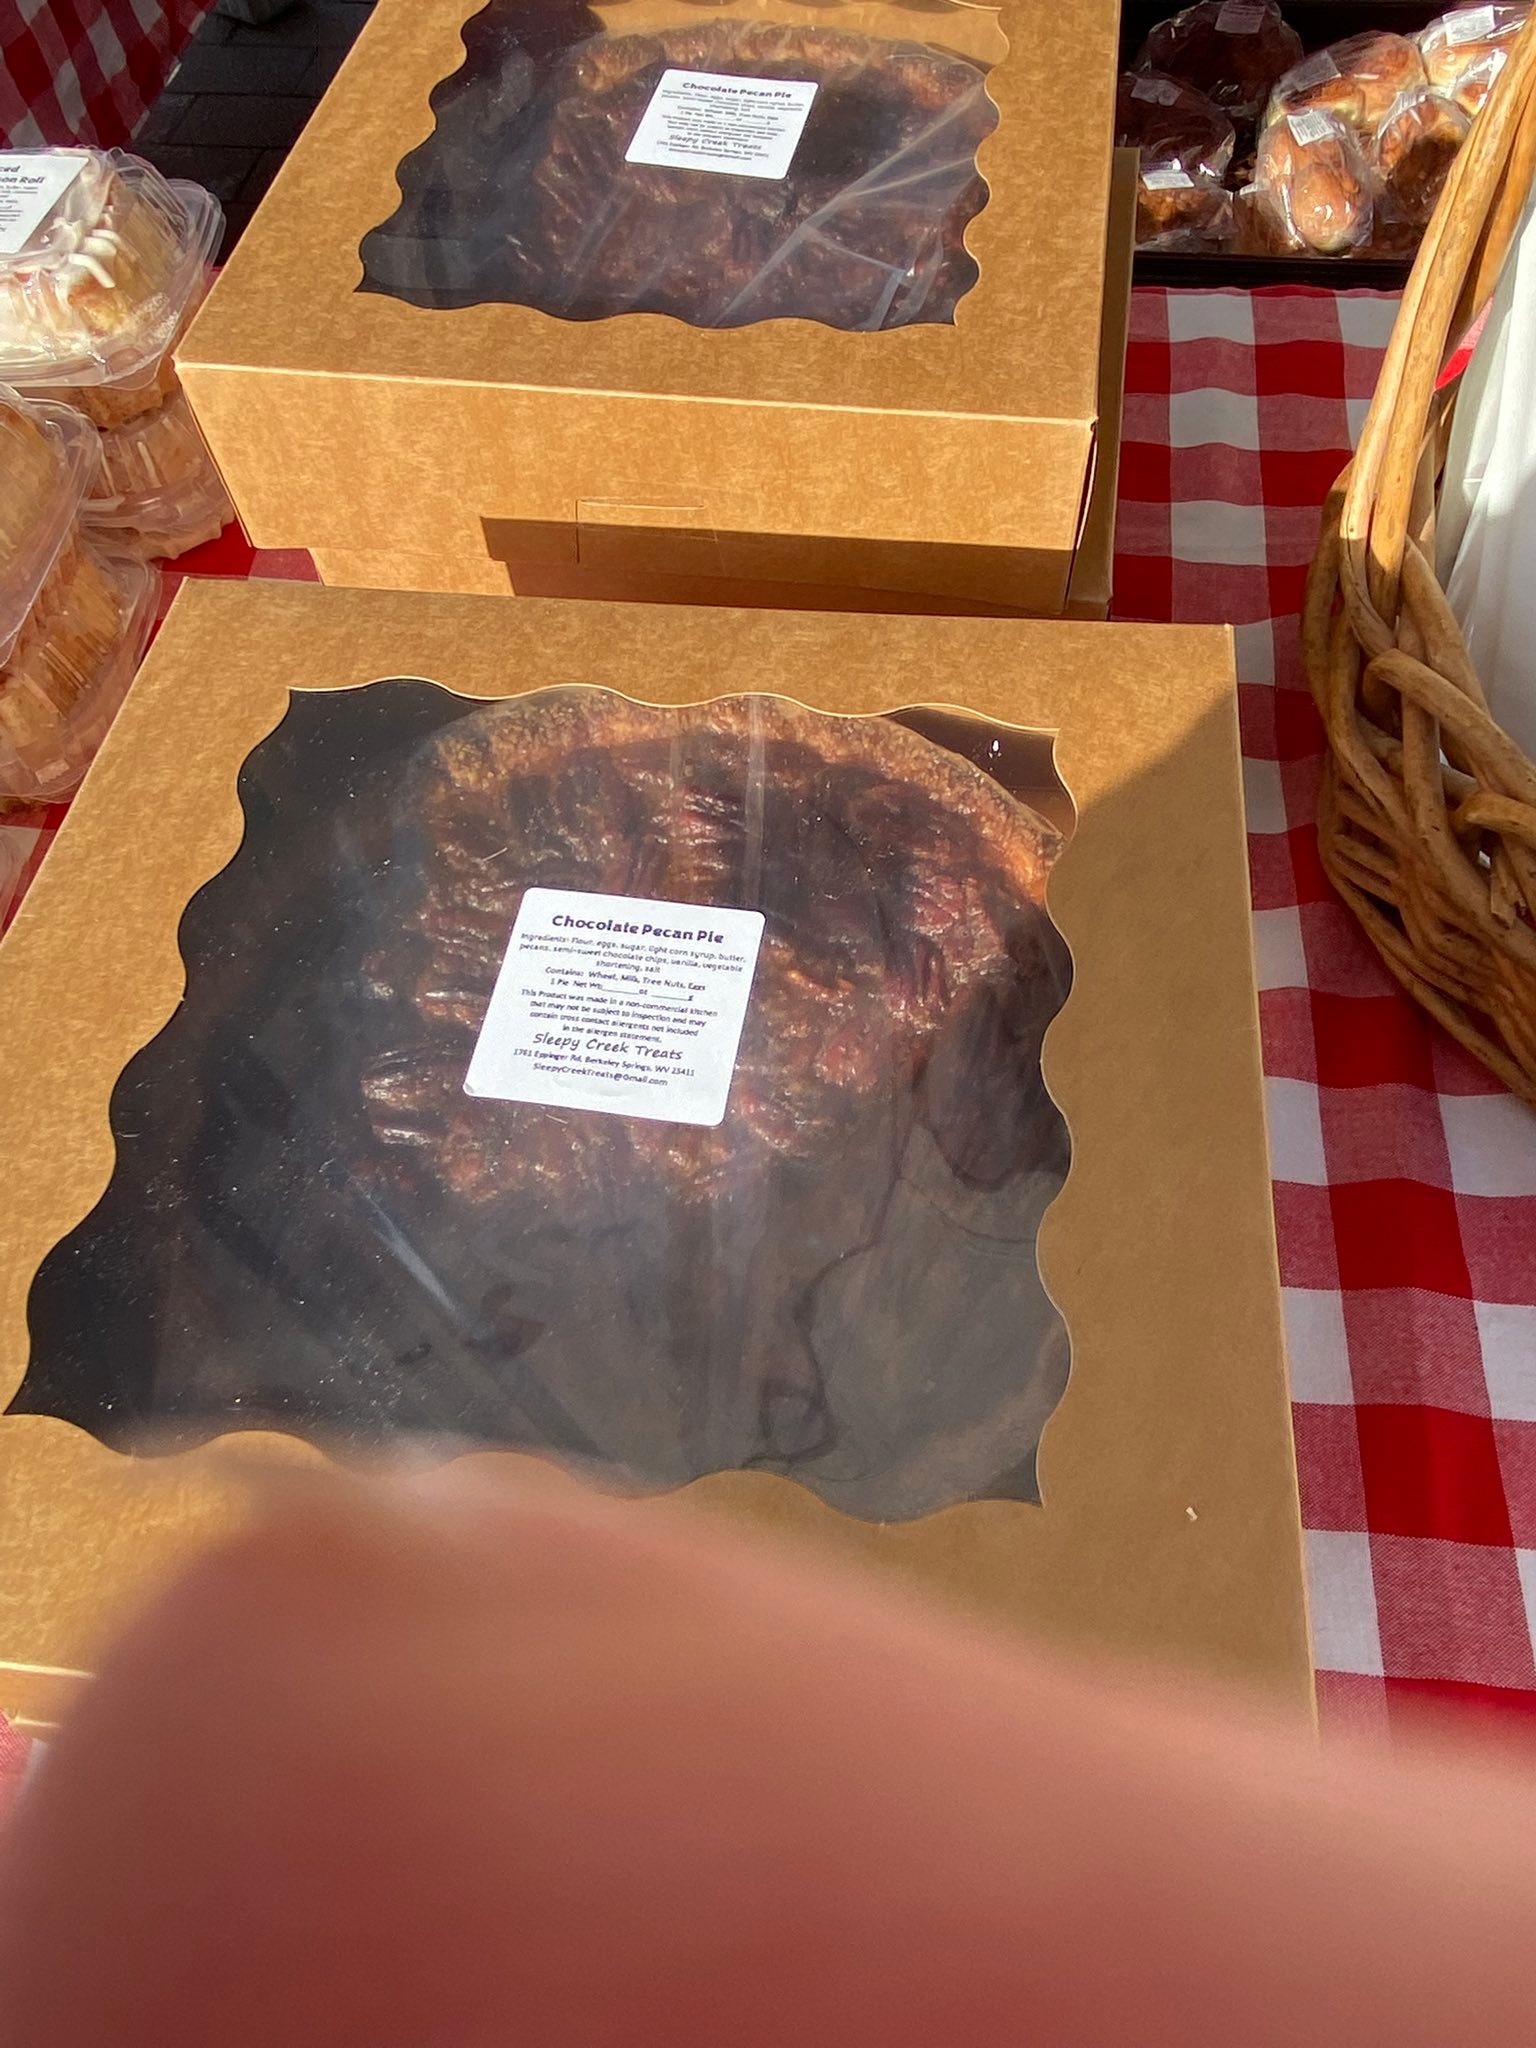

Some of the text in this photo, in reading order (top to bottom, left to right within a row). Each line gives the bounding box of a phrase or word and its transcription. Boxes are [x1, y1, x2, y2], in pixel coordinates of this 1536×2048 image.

[682, 82, 738, 94] Chocolate
[739, 89, 772, 97] Pecan
[552, 915, 724, 943] Chocolate Pecan Pie
[521, 933, 569, 943] Ingredients:
[620, 943, 646, 952] sugar,
[649, 945, 668, 954] light
[669, 948, 688, 956] corn
[690, 951, 717, 960] syrup,
[719, 953, 746, 963] butter,
[553, 946, 601, 957] semi-sweet
[602, 950, 643, 960] chocolate
[645, 955, 669, 964] chips,
[671, 959, 700, 968] vanilla,
[702, 963, 743, 972] vegetable
[545, 966, 584, 976] Contains:
[588, 971, 618, 980] Wheat,
[642, 977, 662, 985] Tree
[664, 980, 686, 989] Nuts,
[688, 982, 706, 991] Eggs
[596, 960, 643, 972] shortening,
[557, 979, 569, 987] Pie
[573, 980, 587, 988] Net
[521, 988, 536, 997] This
[538, 990, 567, 1000] Product
[586, 996, 608, 1004] made
[609, 997, 617, 1005] in
[625, 1001, 688, 1013] non-commercial
[690, 1008, 718, 1017] kitchen
[547, 1003, 565, 1011] may
[593, 1007, 620, 1015] subject
[632, 1011, 670, 1022] inspection
[688, 1019, 706, 1027] may
[529, 1011, 558, 1019] contain
[581, 1017, 609, 1025] contact
[666, 1025, 699, 1037] included
[586, 1028, 618, 1037] allergen
[620, 1031, 662, 1043] statement.
[533, 1032, 683, 1060] Sleepy Creek Treats
[585, 1056, 620, 1067] Berkeley
[655, 1065, 670, 1073] WV
